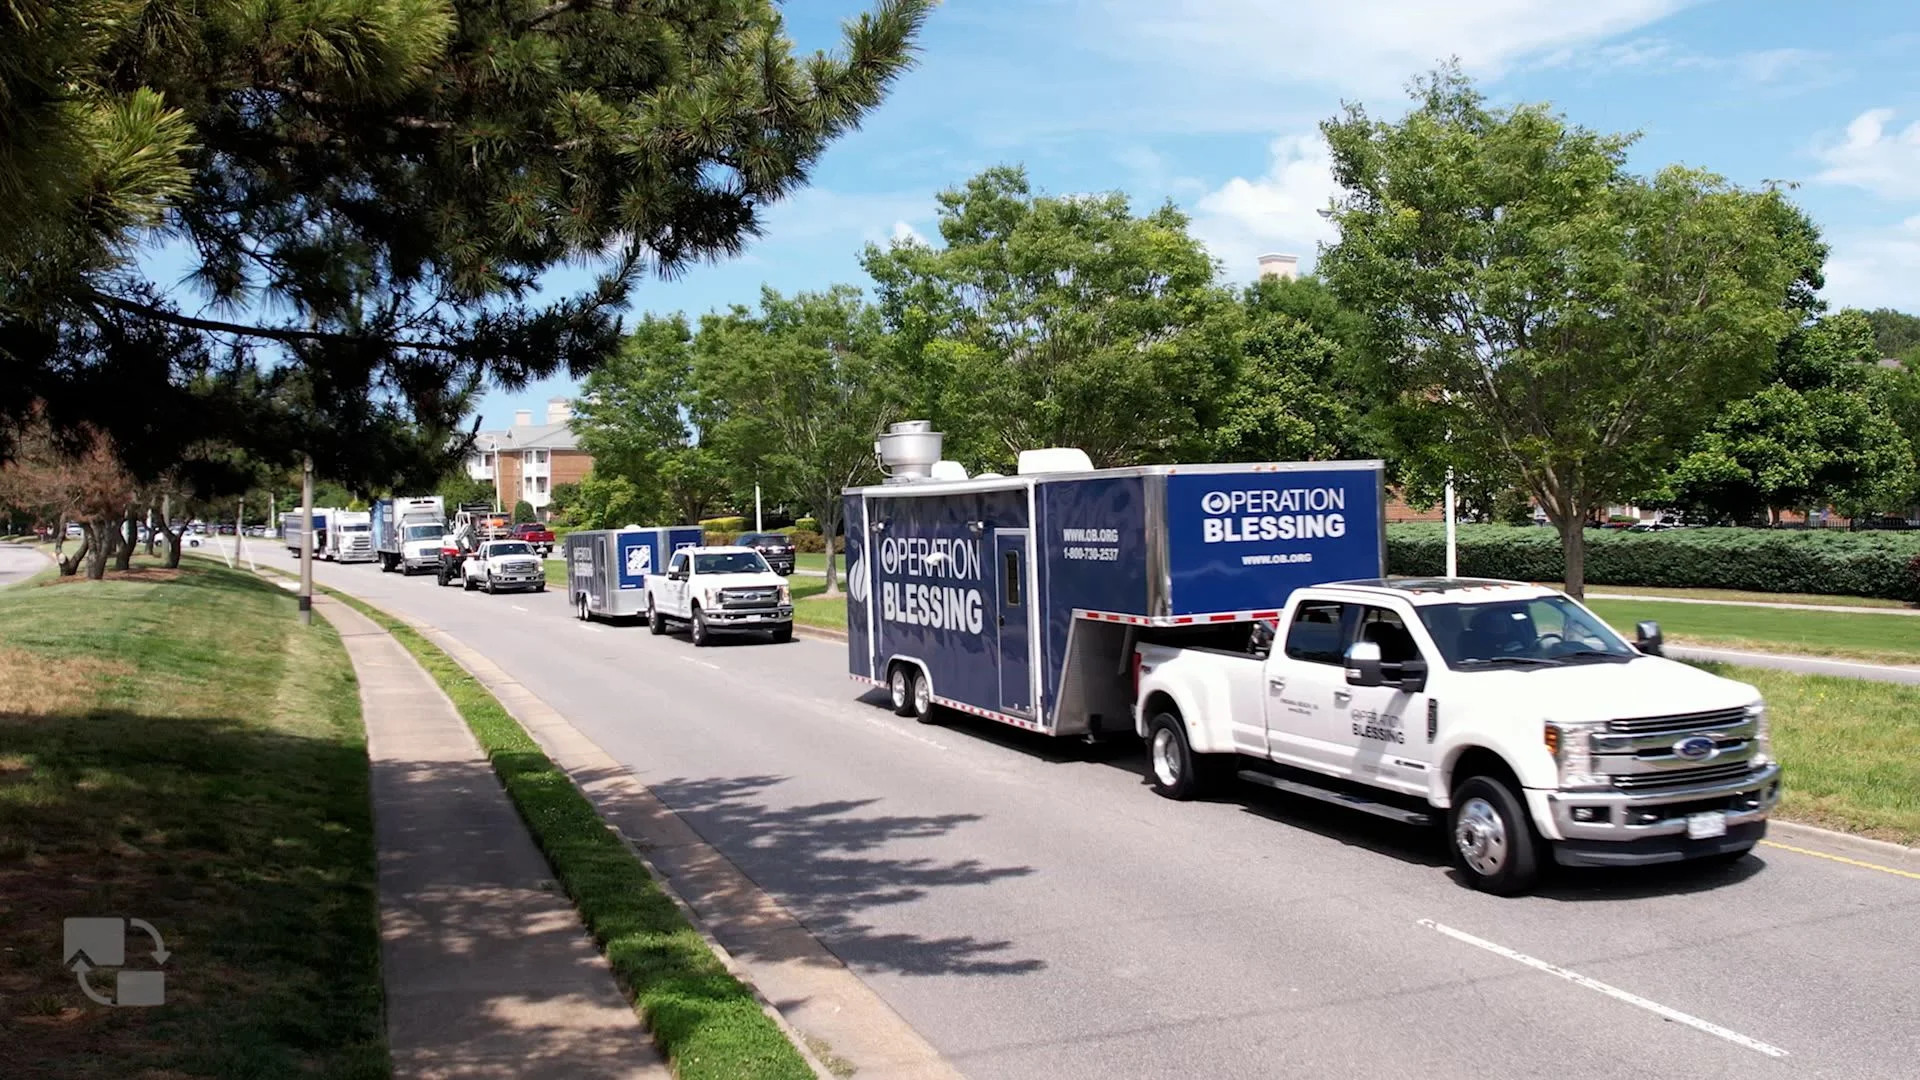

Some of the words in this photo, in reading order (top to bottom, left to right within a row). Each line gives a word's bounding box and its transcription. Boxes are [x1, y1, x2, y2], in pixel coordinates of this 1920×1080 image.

[1201, 488, 1345, 515] OPERATION
[1063, 528, 1119, 543] WWW.OB.ORG
[1203, 513, 1346, 543] BLESSING
[881, 537, 981, 580] OPERATION
[1241, 553, 1313, 565] WWW.OB.ORG
[883, 581, 983, 635] BLESSING
[1352, 723, 1405, 745] BLESSING
